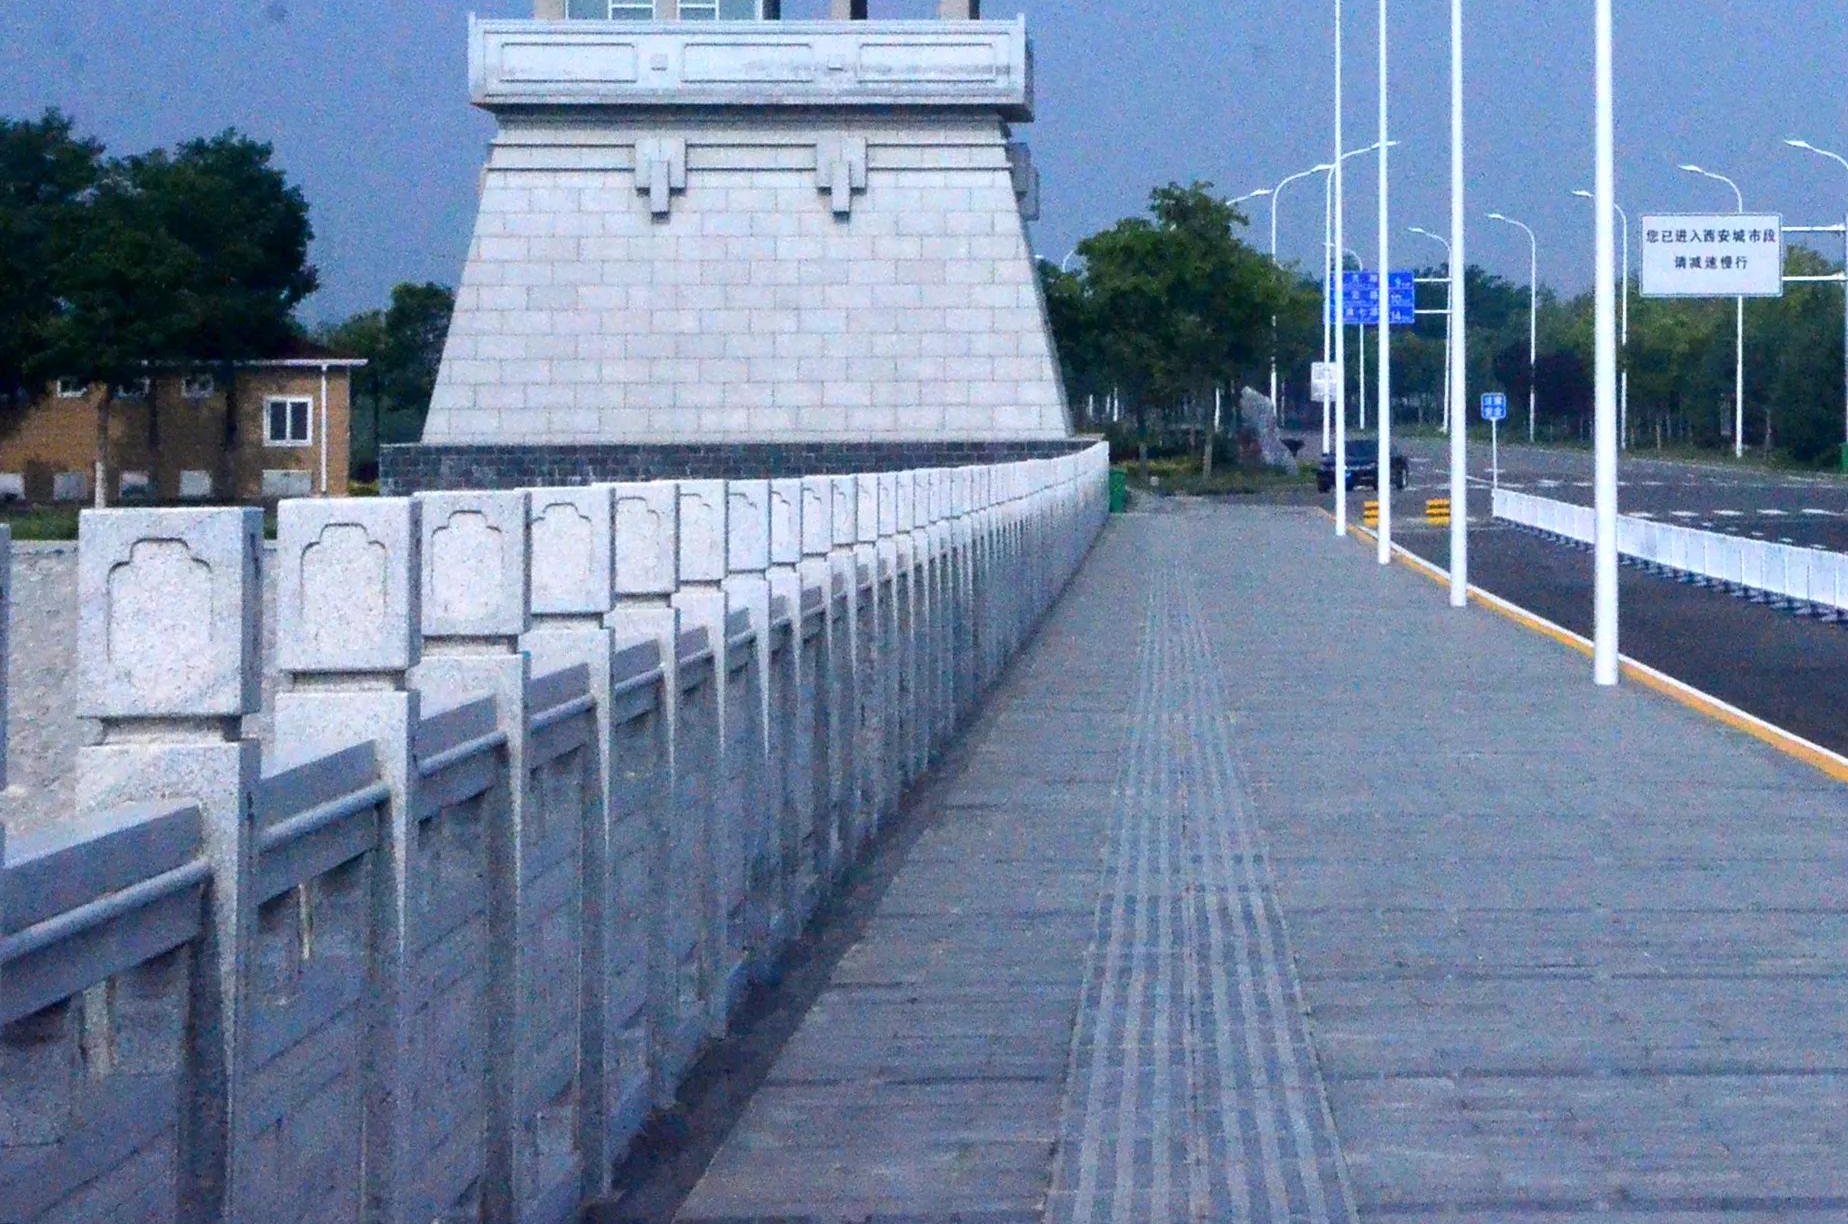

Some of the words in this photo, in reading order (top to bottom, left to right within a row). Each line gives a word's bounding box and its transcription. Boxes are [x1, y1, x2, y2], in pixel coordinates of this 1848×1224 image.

[1646, 229, 1776, 243] 您已进入西安城市段
[1674, 256, 1747, 269] 请减速慢行
